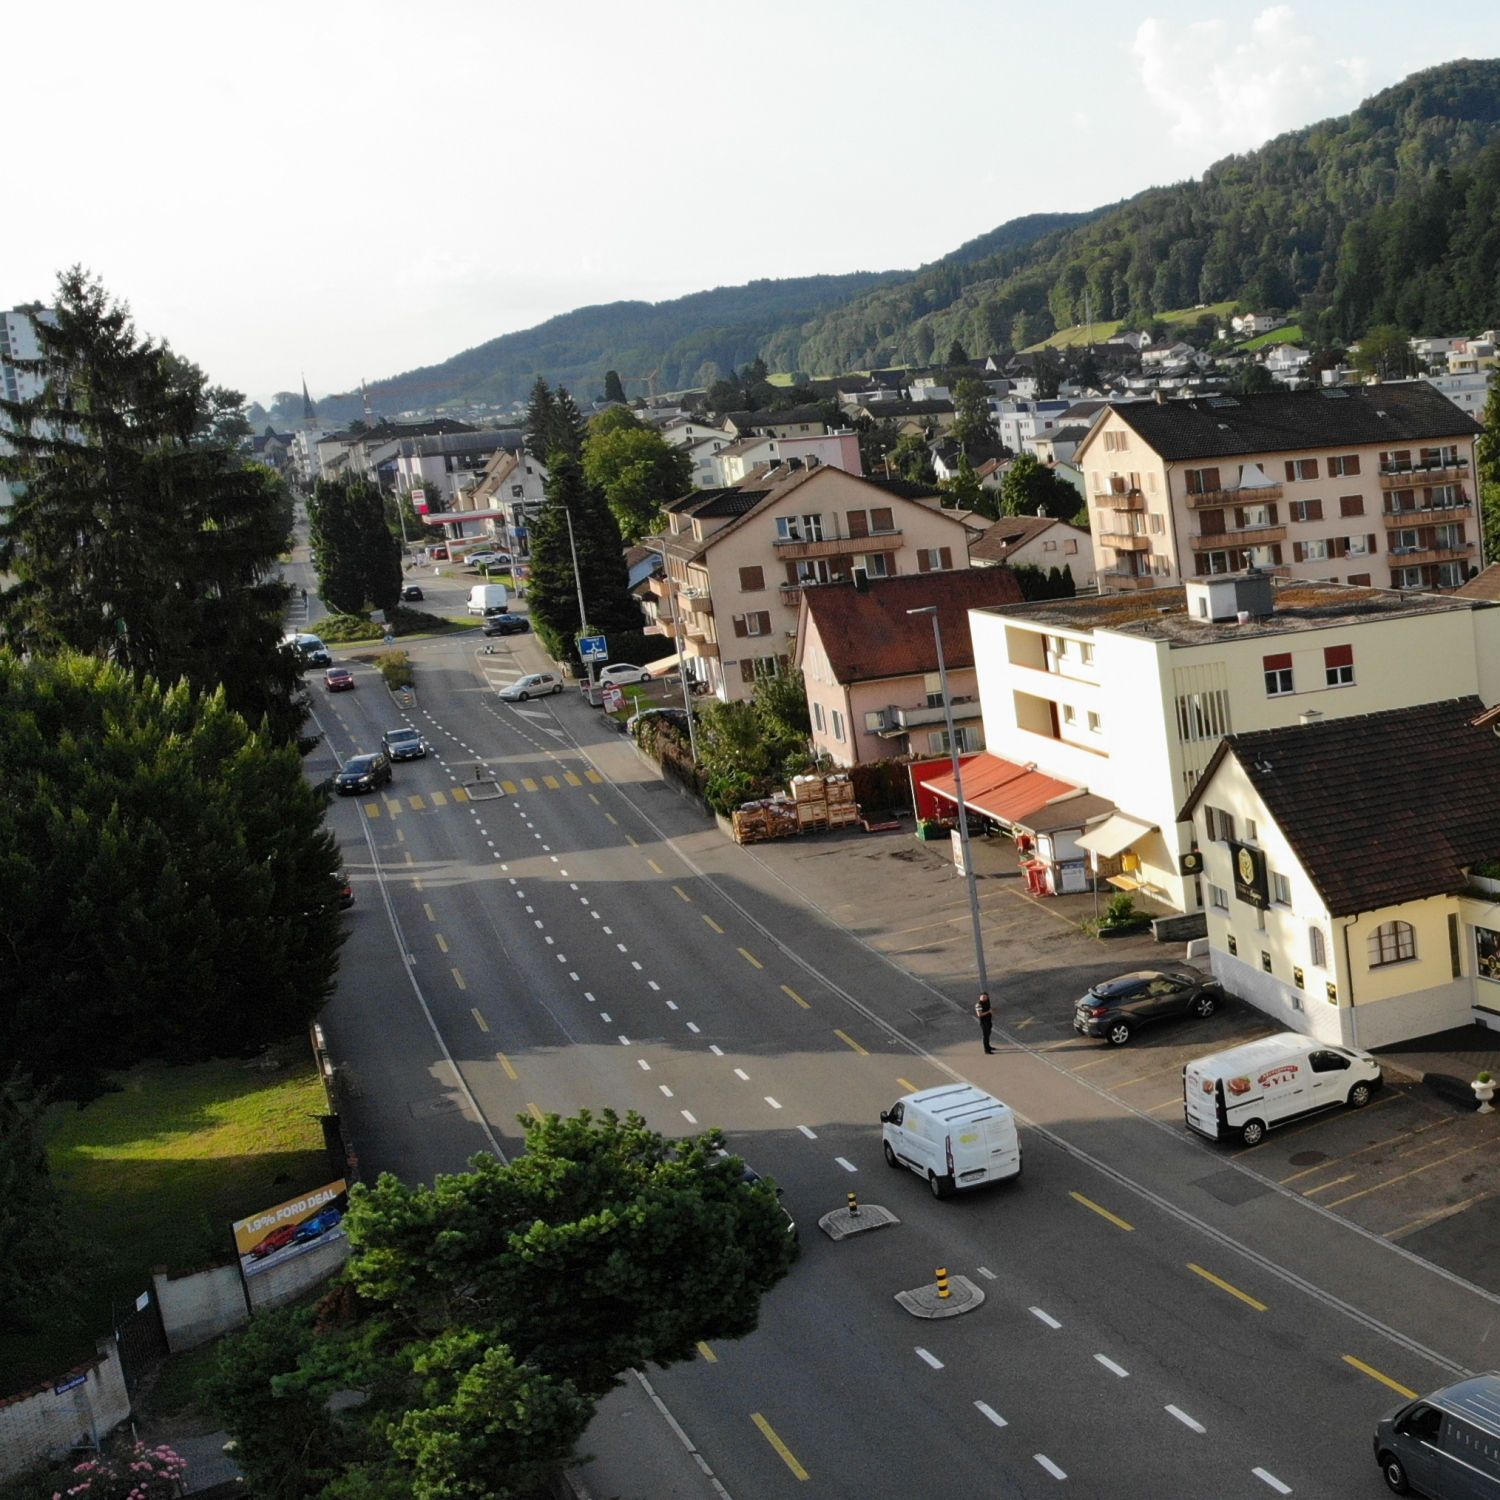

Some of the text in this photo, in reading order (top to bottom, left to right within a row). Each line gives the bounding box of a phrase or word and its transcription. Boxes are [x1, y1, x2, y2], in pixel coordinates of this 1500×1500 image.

[245, 1189, 337, 1233] 1.9% FORD DEAL
